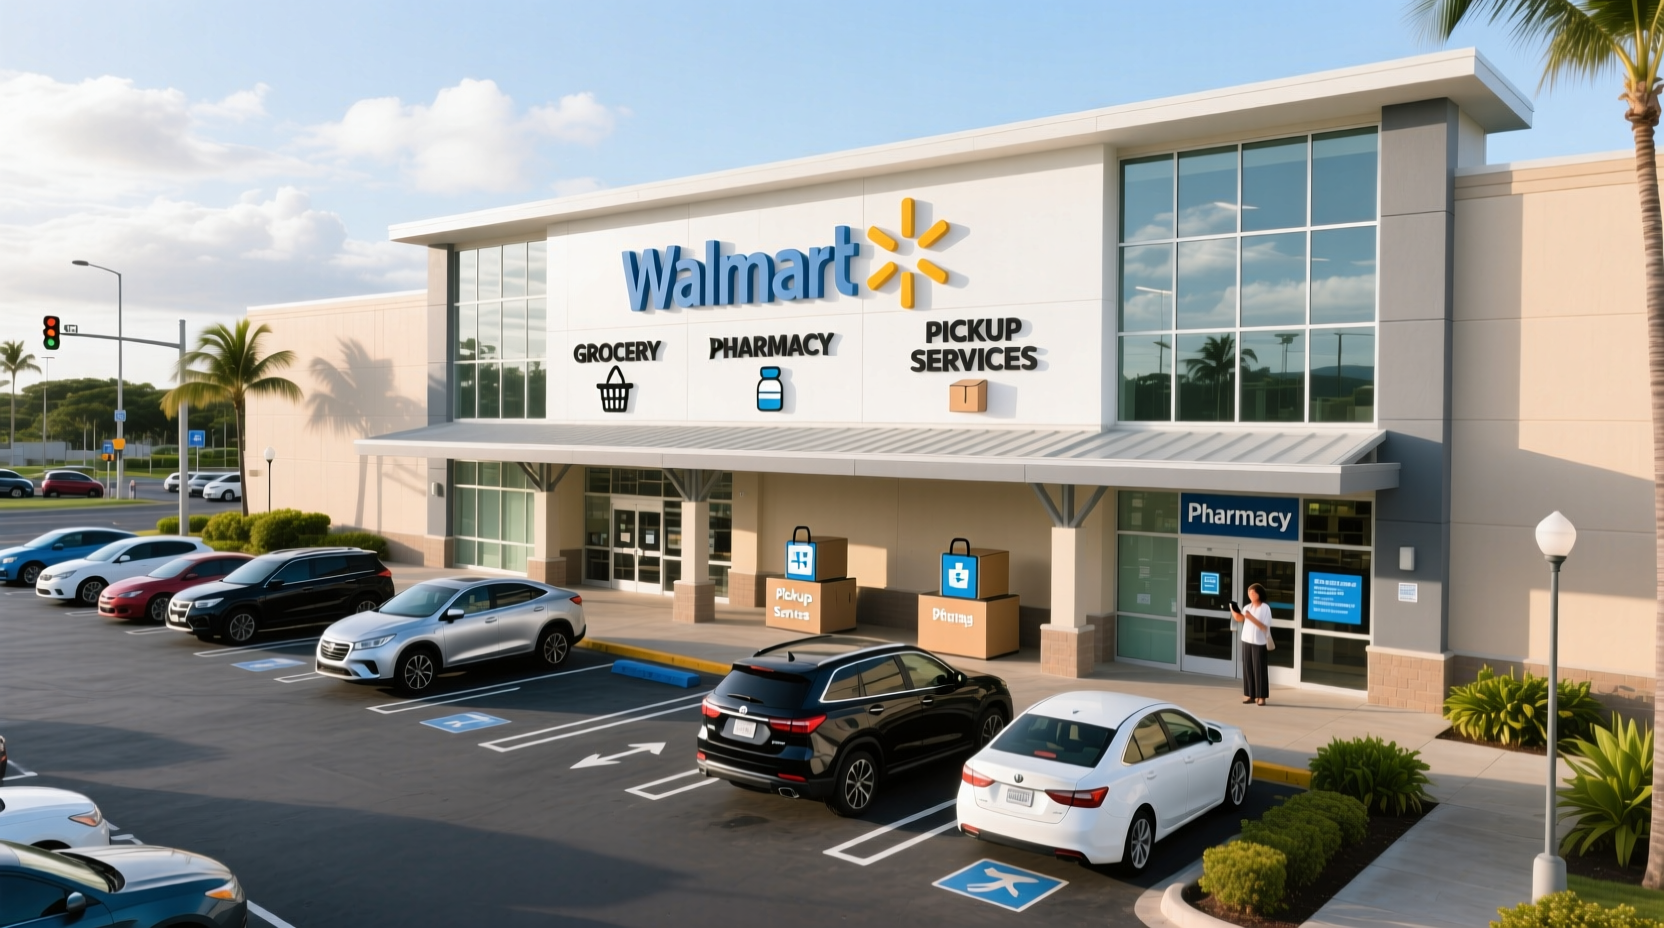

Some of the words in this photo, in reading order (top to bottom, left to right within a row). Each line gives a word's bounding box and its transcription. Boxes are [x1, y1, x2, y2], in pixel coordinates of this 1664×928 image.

[621, 225, 860, 311] Walmart
[926, 317, 1022, 343] PICKUP
[573, 340, 661, 363] GROCERY
[709, 332, 834, 360] PHARMACY
[910, 345, 1038, 372] SERVICES
[1188, 502, 1292, 532] Pharmacy
